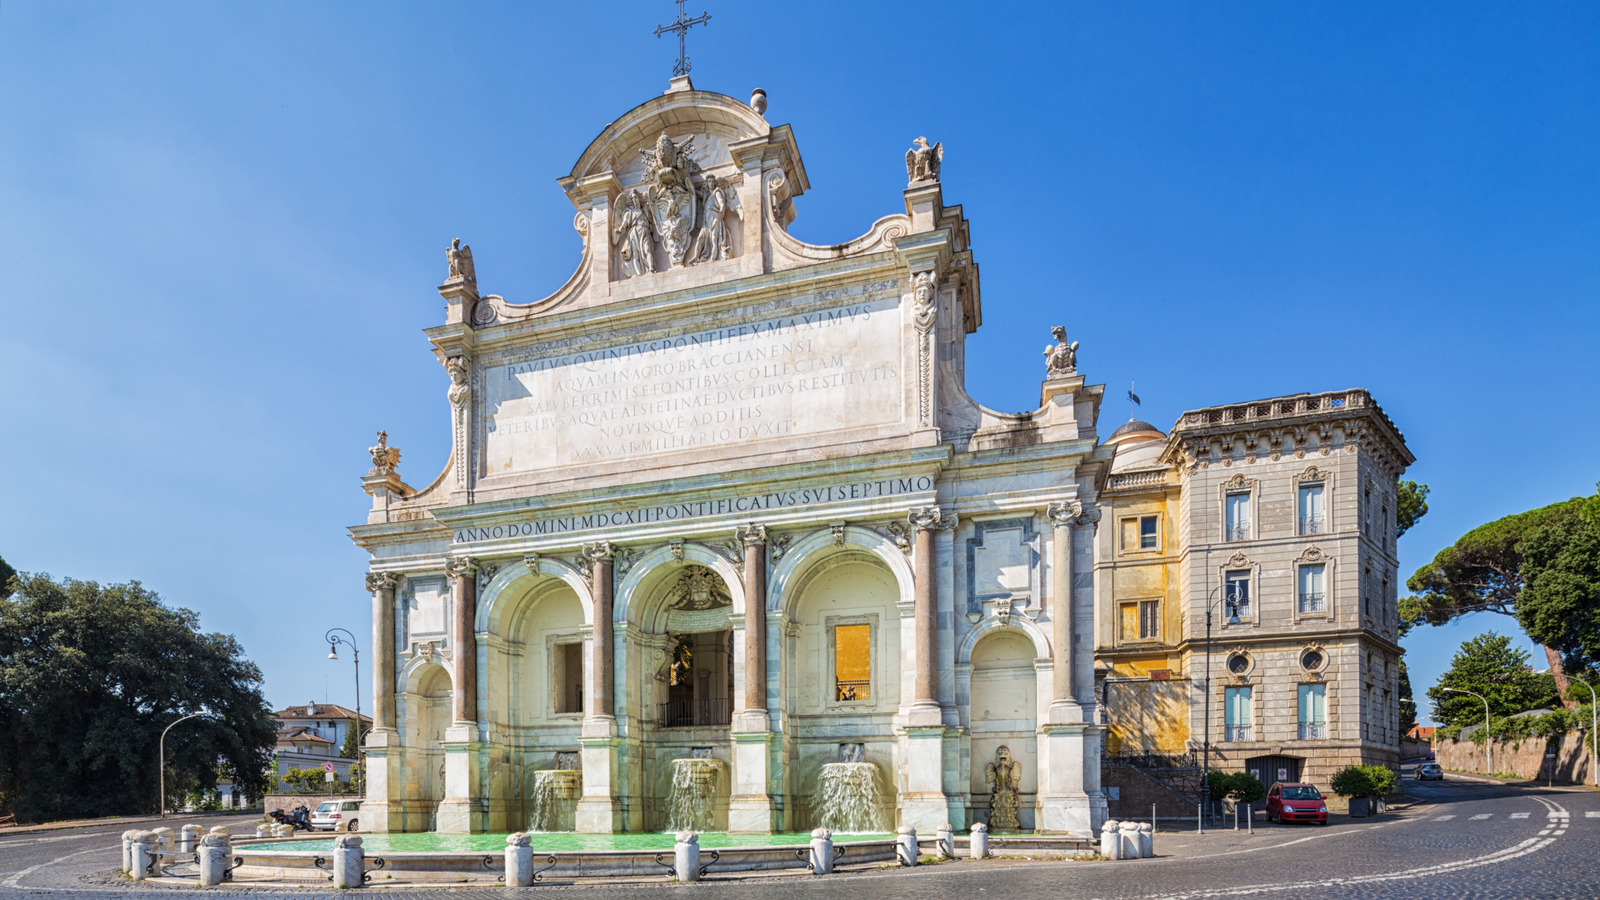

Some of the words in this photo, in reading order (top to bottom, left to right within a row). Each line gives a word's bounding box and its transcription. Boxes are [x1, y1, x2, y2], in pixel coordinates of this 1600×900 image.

[508, 358, 568, 380] PAVLVS
[574, 342, 657, 372] QVINTVS
[662, 324, 762, 354] PONTIFEX
[766, 304, 871, 338] MAXIMVS
[555, 374, 609, 393] AQVAM
[612, 370, 630, 384] IN
[634, 363, 674, 380] AGRO
[679, 339, 812, 373] BRACCIANENSI
[568, 407, 620, 427] AQVAE
[622, 394, 712, 418] ALSIETINAE
[717, 381, 794, 404] DVCTIBVS
[799, 364, 897, 392] RESTITVTIS
[653, 372, 730, 397] FONTIBVS
[734, 354, 844, 382] COLLECTAM
[690, 405, 762, 428] ADDITIS
[738, 419, 792, 440] DVXIT
[456, 526, 503, 543] ANNO
[507, 517, 576, 538] DOMINI
[581, 509, 650, 530] MDCXII
[655, 491, 797, 521] PONTIFICATVS
[802, 487, 832, 505] SVI
[838, 476, 931, 501] SEPTIMO
